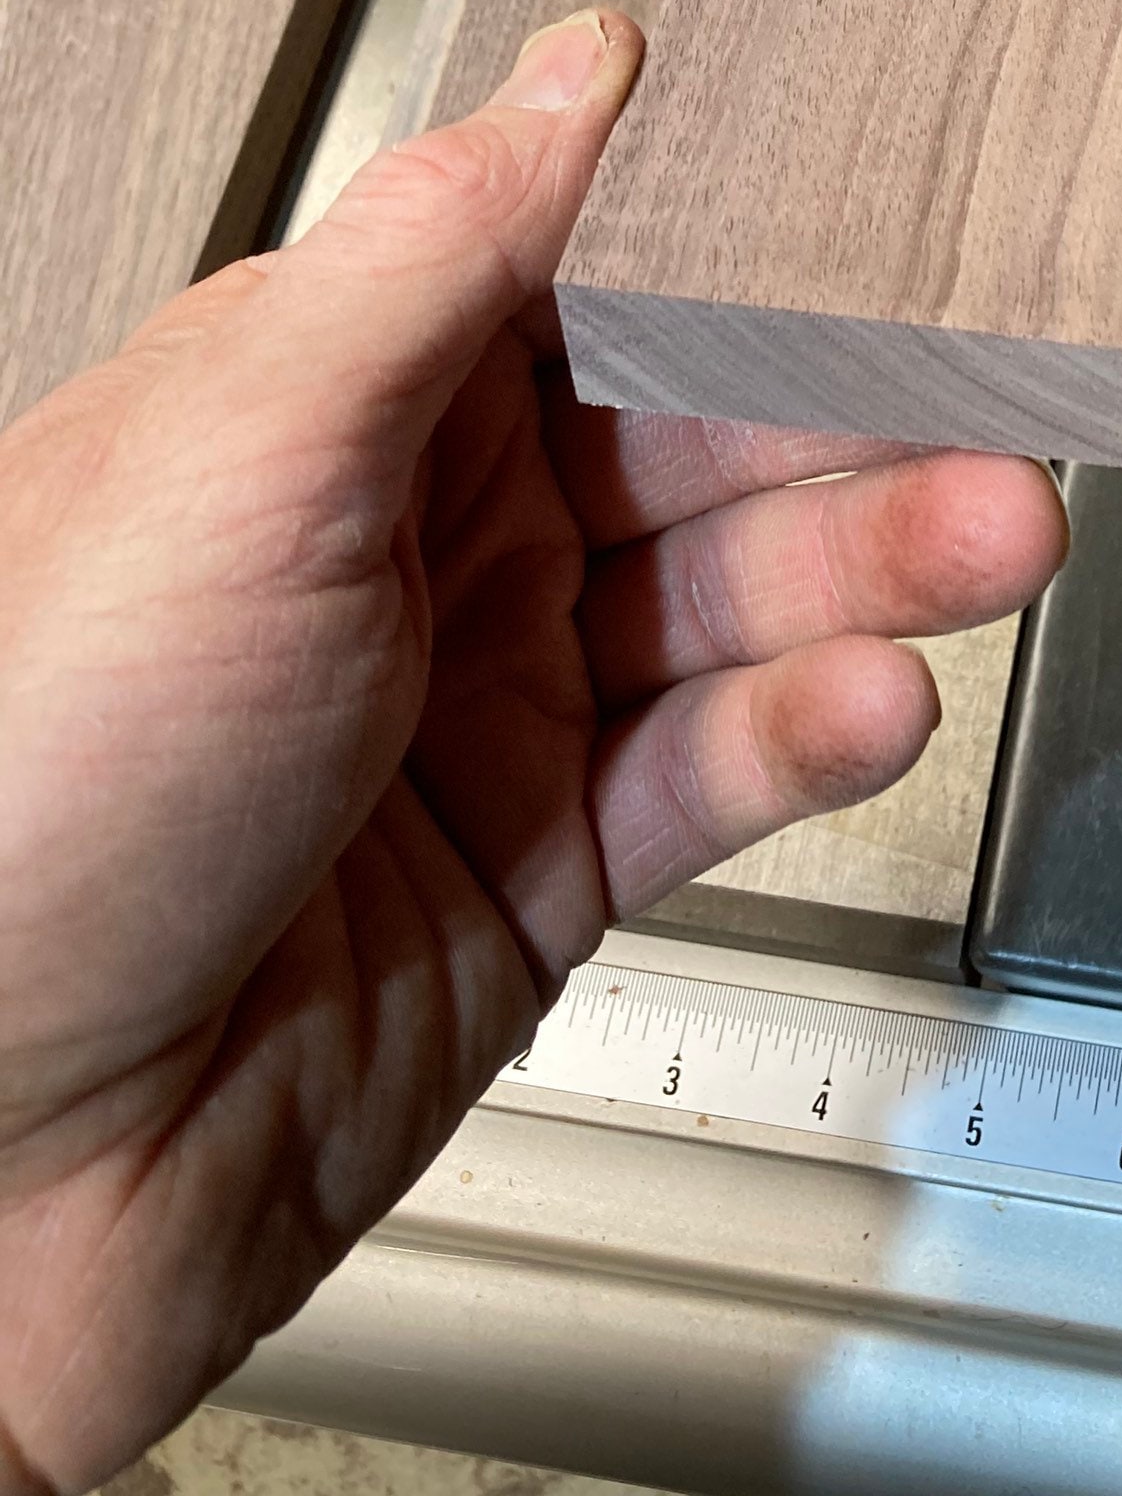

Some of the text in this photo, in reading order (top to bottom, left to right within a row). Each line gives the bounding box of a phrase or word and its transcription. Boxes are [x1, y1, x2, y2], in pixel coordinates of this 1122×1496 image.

[662, 1066, 680, 1096] 3
[811, 1091, 829, 1121] 4
[965, 1115, 984, 1147] 5
